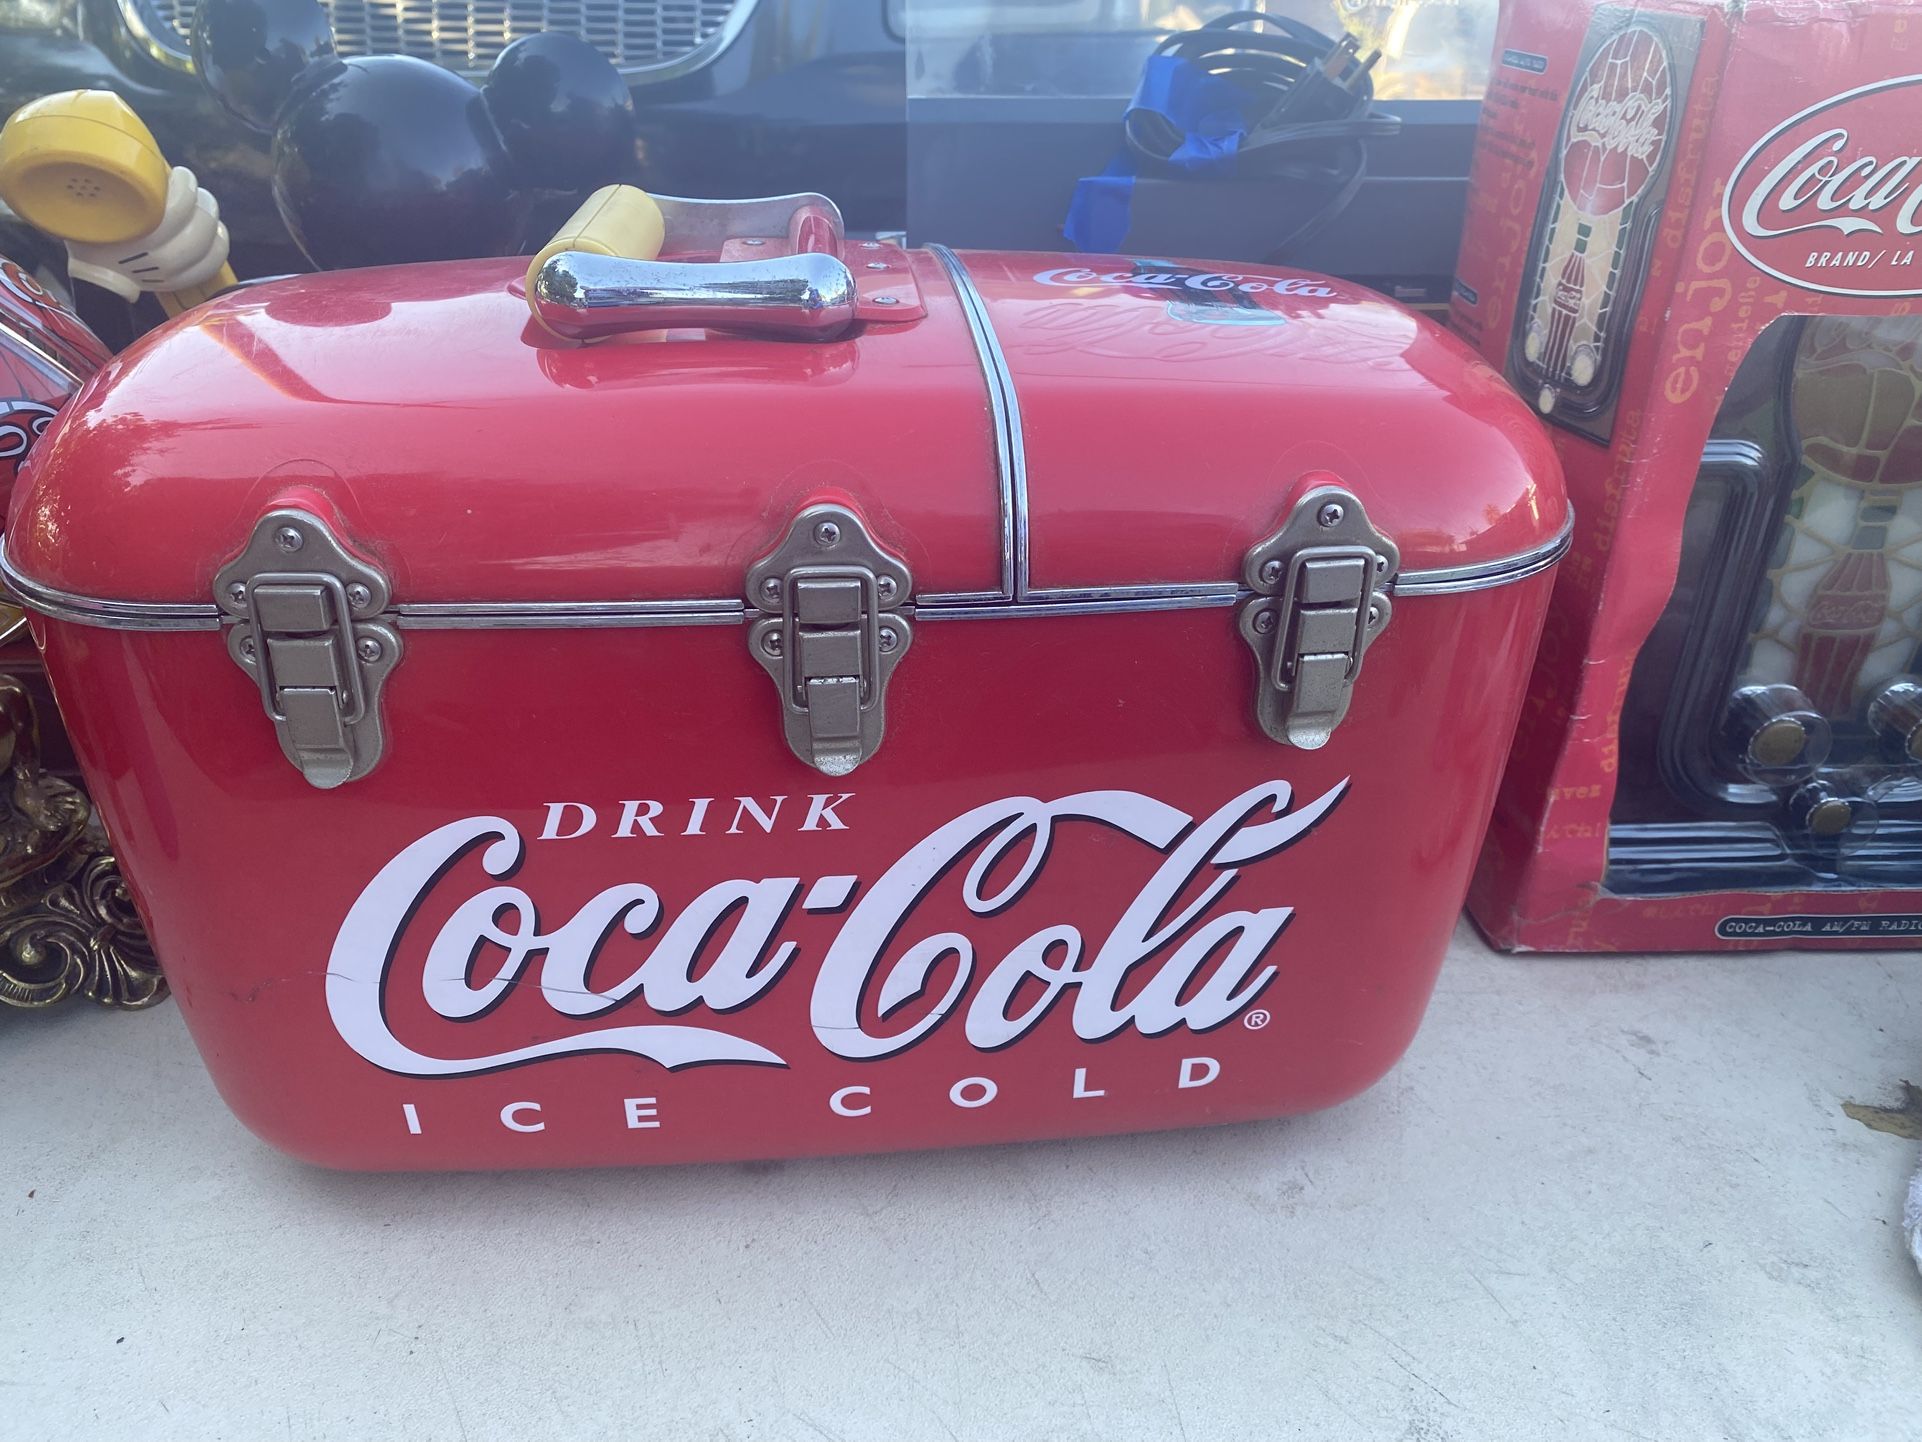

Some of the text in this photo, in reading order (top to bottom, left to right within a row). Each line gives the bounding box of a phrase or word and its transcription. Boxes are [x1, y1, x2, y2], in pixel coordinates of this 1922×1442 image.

[1891, 250, 1914, 266] LA
[1033, 267, 1338, 298] Coca-Cola
[537, 793, 855, 840] DRINK
[326, 776, 1351, 1078] Coca-Cola
[1725, 921, 1812, 933] COCA-COLA
[1821, 919, 1872, 933] AM/FM
[402, 1057, 1221, 1134] ICE COLD
